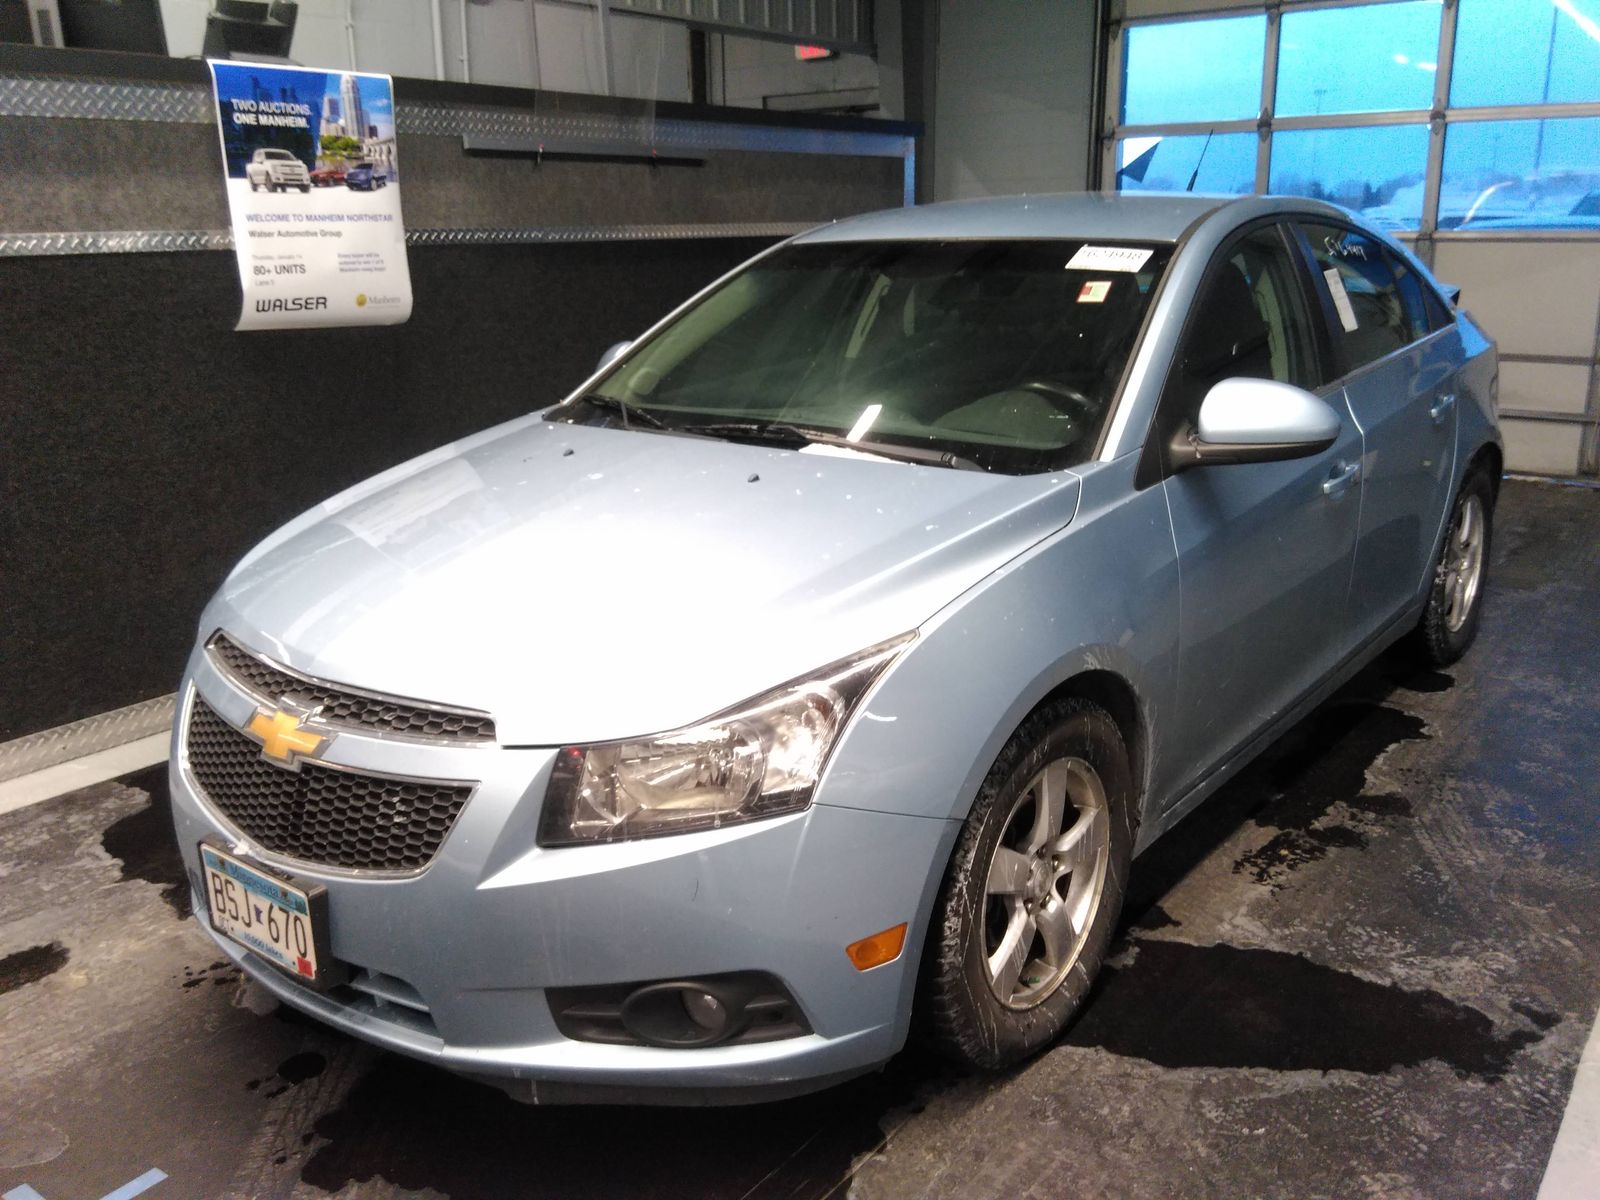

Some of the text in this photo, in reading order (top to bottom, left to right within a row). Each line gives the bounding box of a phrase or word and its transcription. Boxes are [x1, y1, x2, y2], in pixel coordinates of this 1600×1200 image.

[231, 98, 257, 112] TWO
[232, 112, 257, 125] ONE
[246, 213, 393, 222] WELCOME TO MANHEIM NORTHSTAR
[248, 229, 343, 239] Walser Automotive Group
[253, 264, 306, 275] 80+ UNITS
[256, 296, 328, 313] WALSER
[211, 871, 307, 959] BSJ 670
